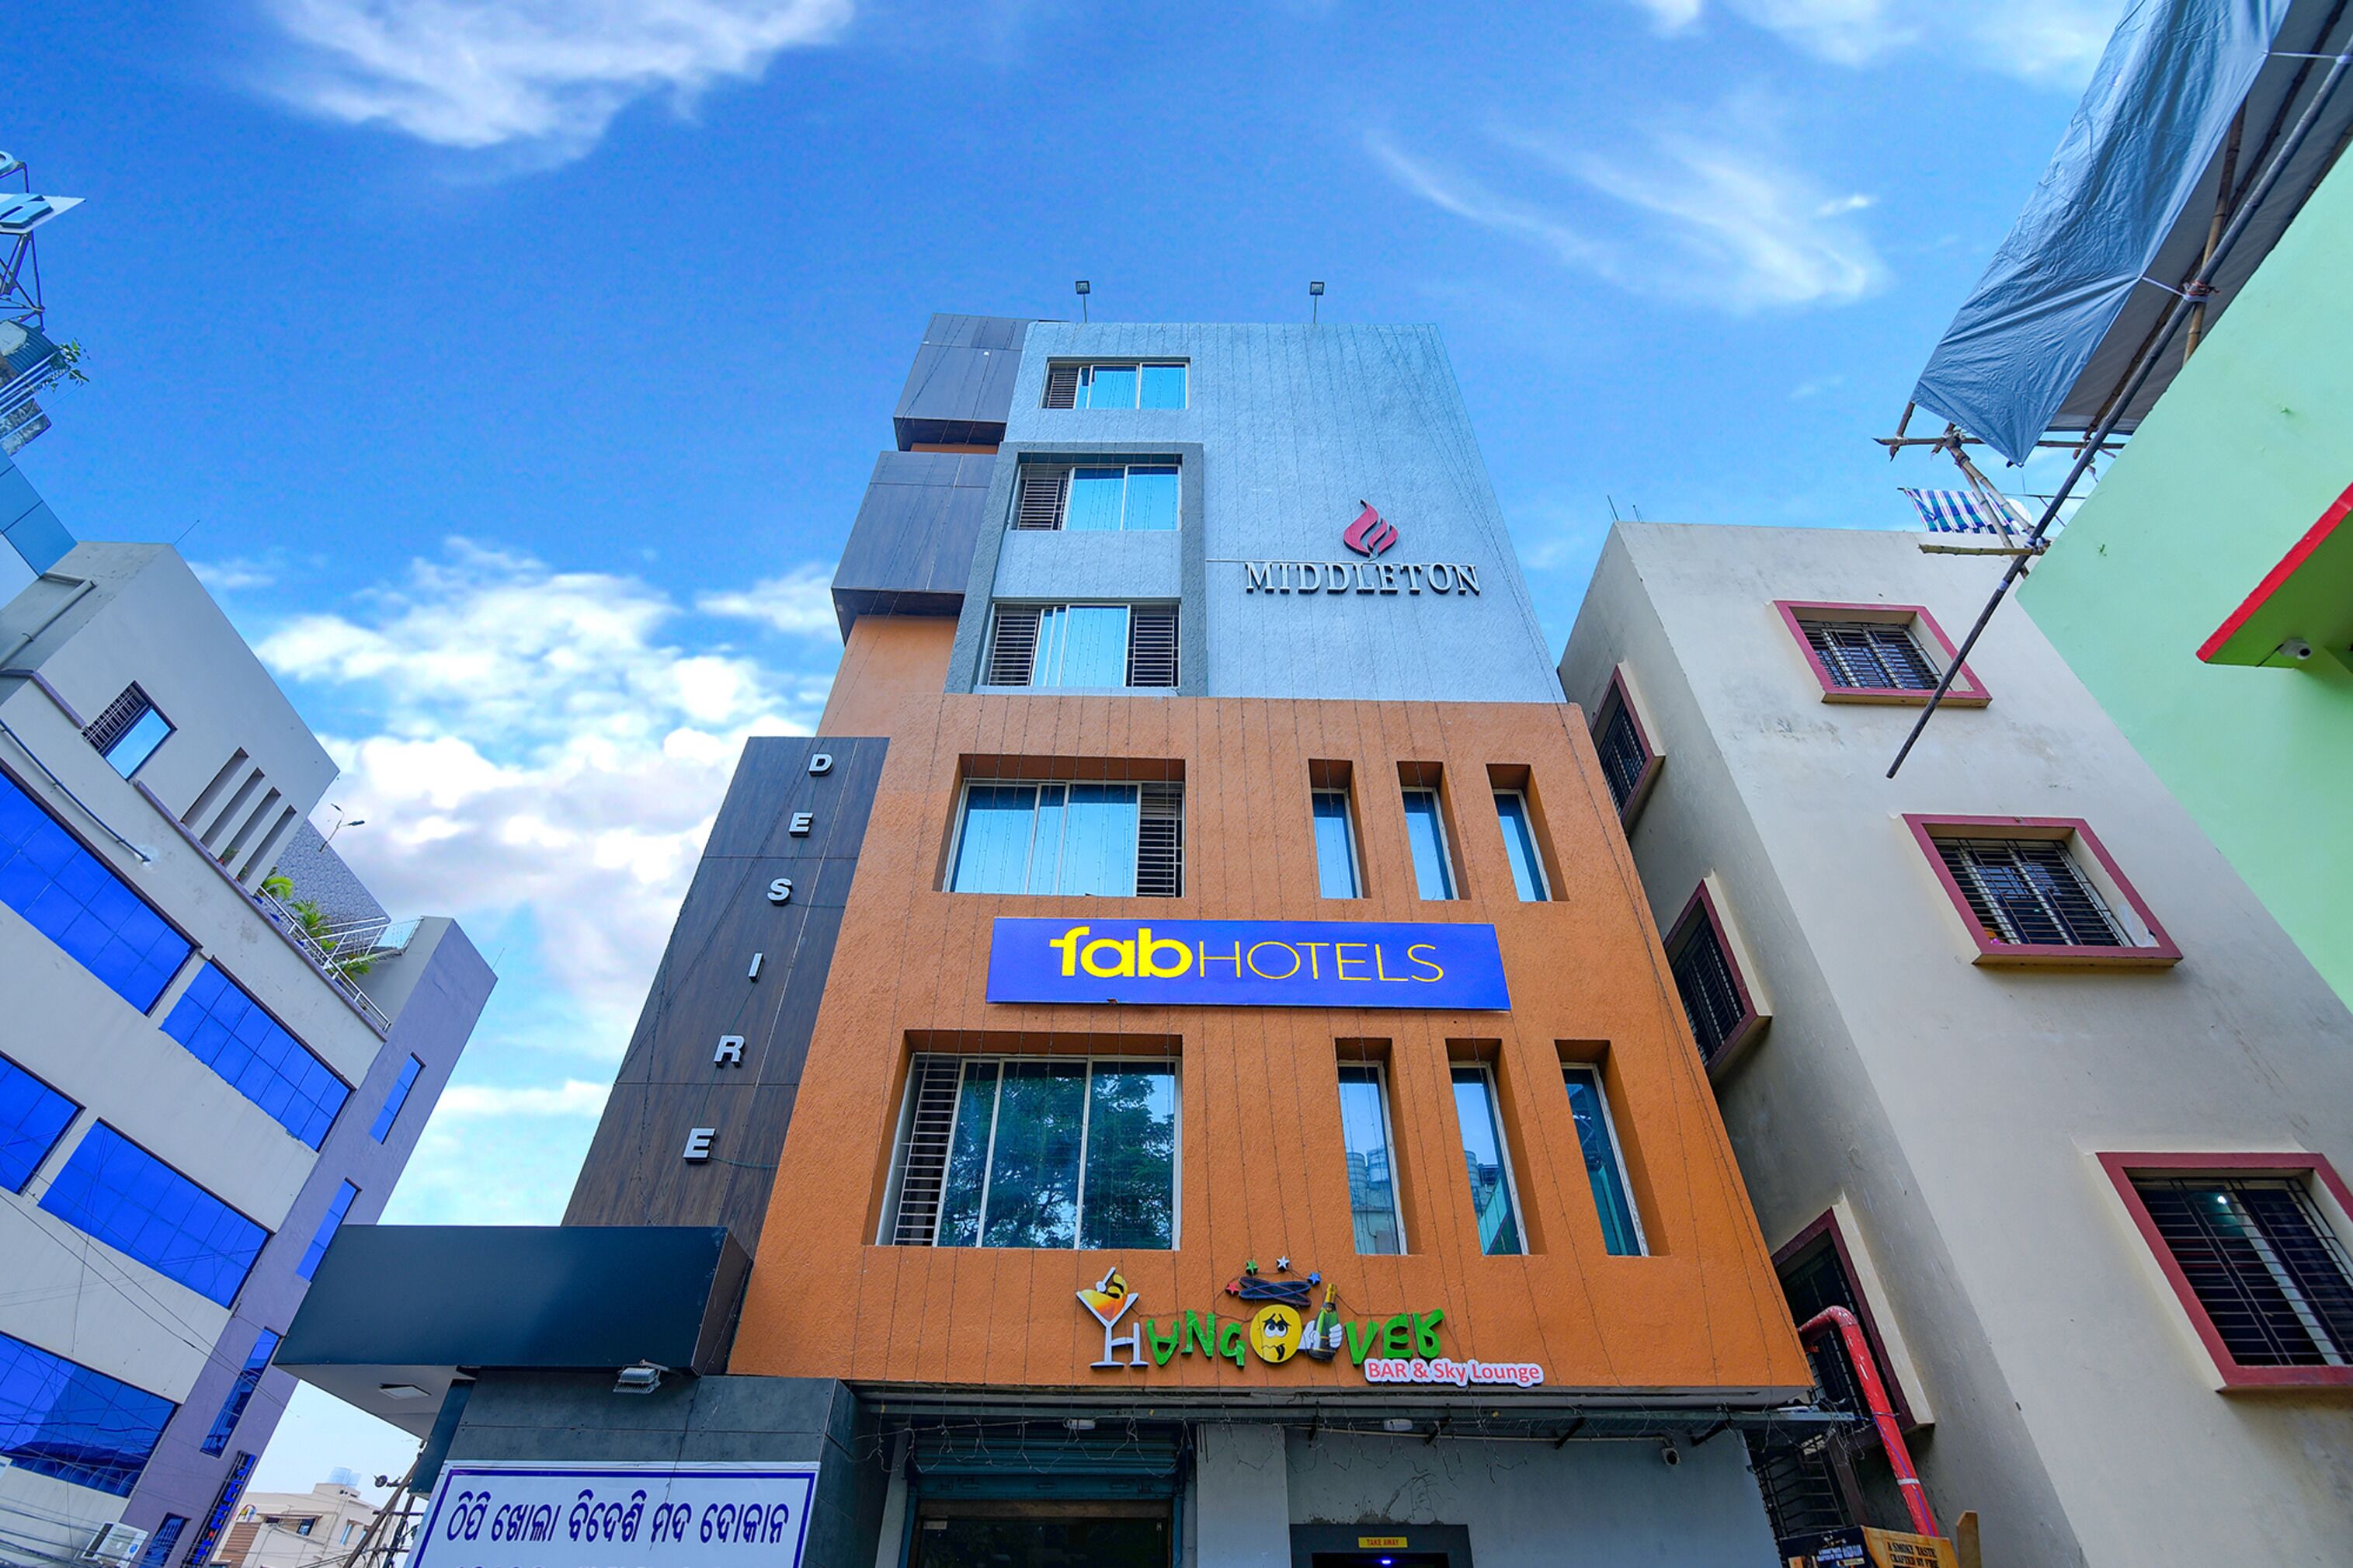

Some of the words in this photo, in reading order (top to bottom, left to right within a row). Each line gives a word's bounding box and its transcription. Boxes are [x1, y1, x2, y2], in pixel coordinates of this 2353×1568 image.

[1245, 561, 1480, 596] MIDDLETON
[683, 753, 833, 1163] DESIRE
[1368, 1362, 1407, 1379] BAR
[1413, 1362, 1428, 1379] &
[1434, 1362, 1466, 1382] Sky
[1472, 1364, 1540, 1383] Lounge
[651, 1502, 692, 1543] ମଦ
[699, 1502, 790, 1544] ଦୋକାନ
